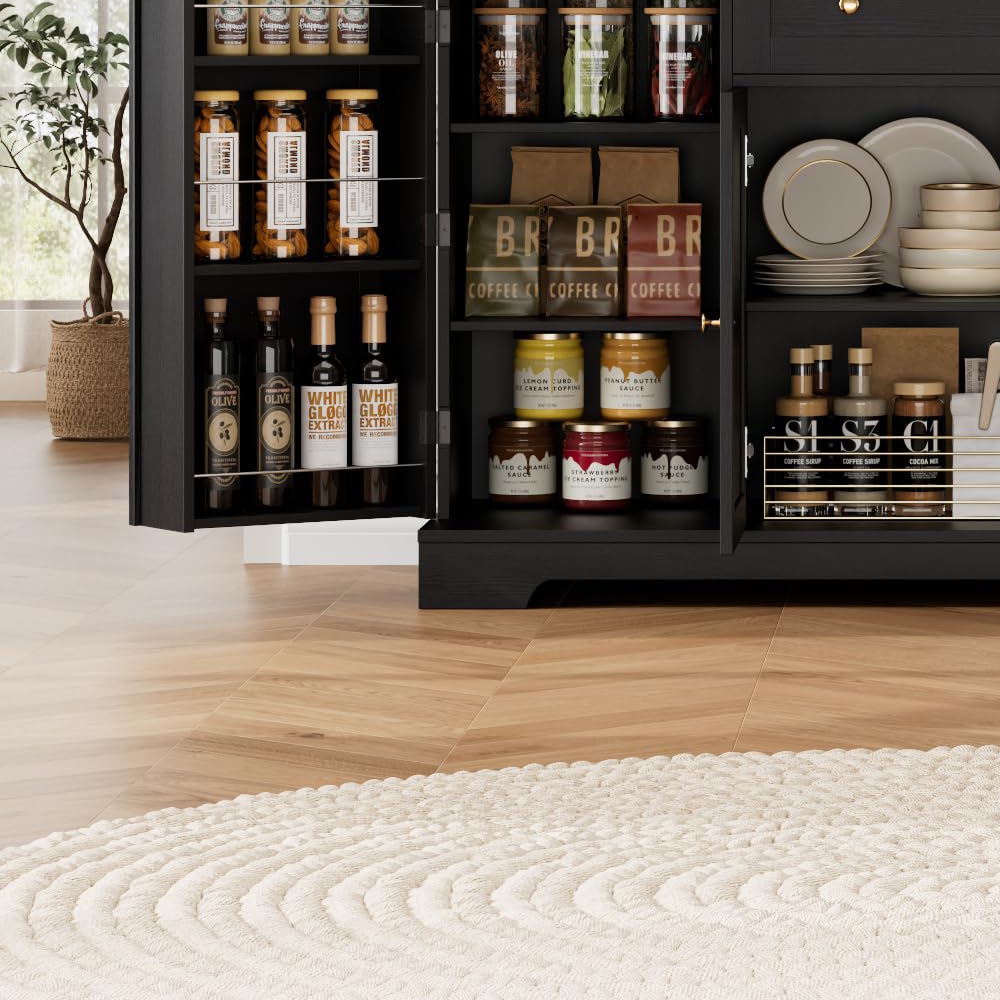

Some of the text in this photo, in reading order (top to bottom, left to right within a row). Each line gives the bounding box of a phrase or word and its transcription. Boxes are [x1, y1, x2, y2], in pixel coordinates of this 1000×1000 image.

[495, 51, 517, 59] OLIVE
[469, 283, 518, 298] COFFEE
[550, 283, 598, 298] COFFEE
[631, 283, 680, 298] COFFEE
[212, 396, 237, 406] OLIVE
[265, 394, 290, 404] OLIVE
[784, 420, 820, 453] S1
[841, 420, 880, 453] S3
[904, 420, 938, 453] C1
